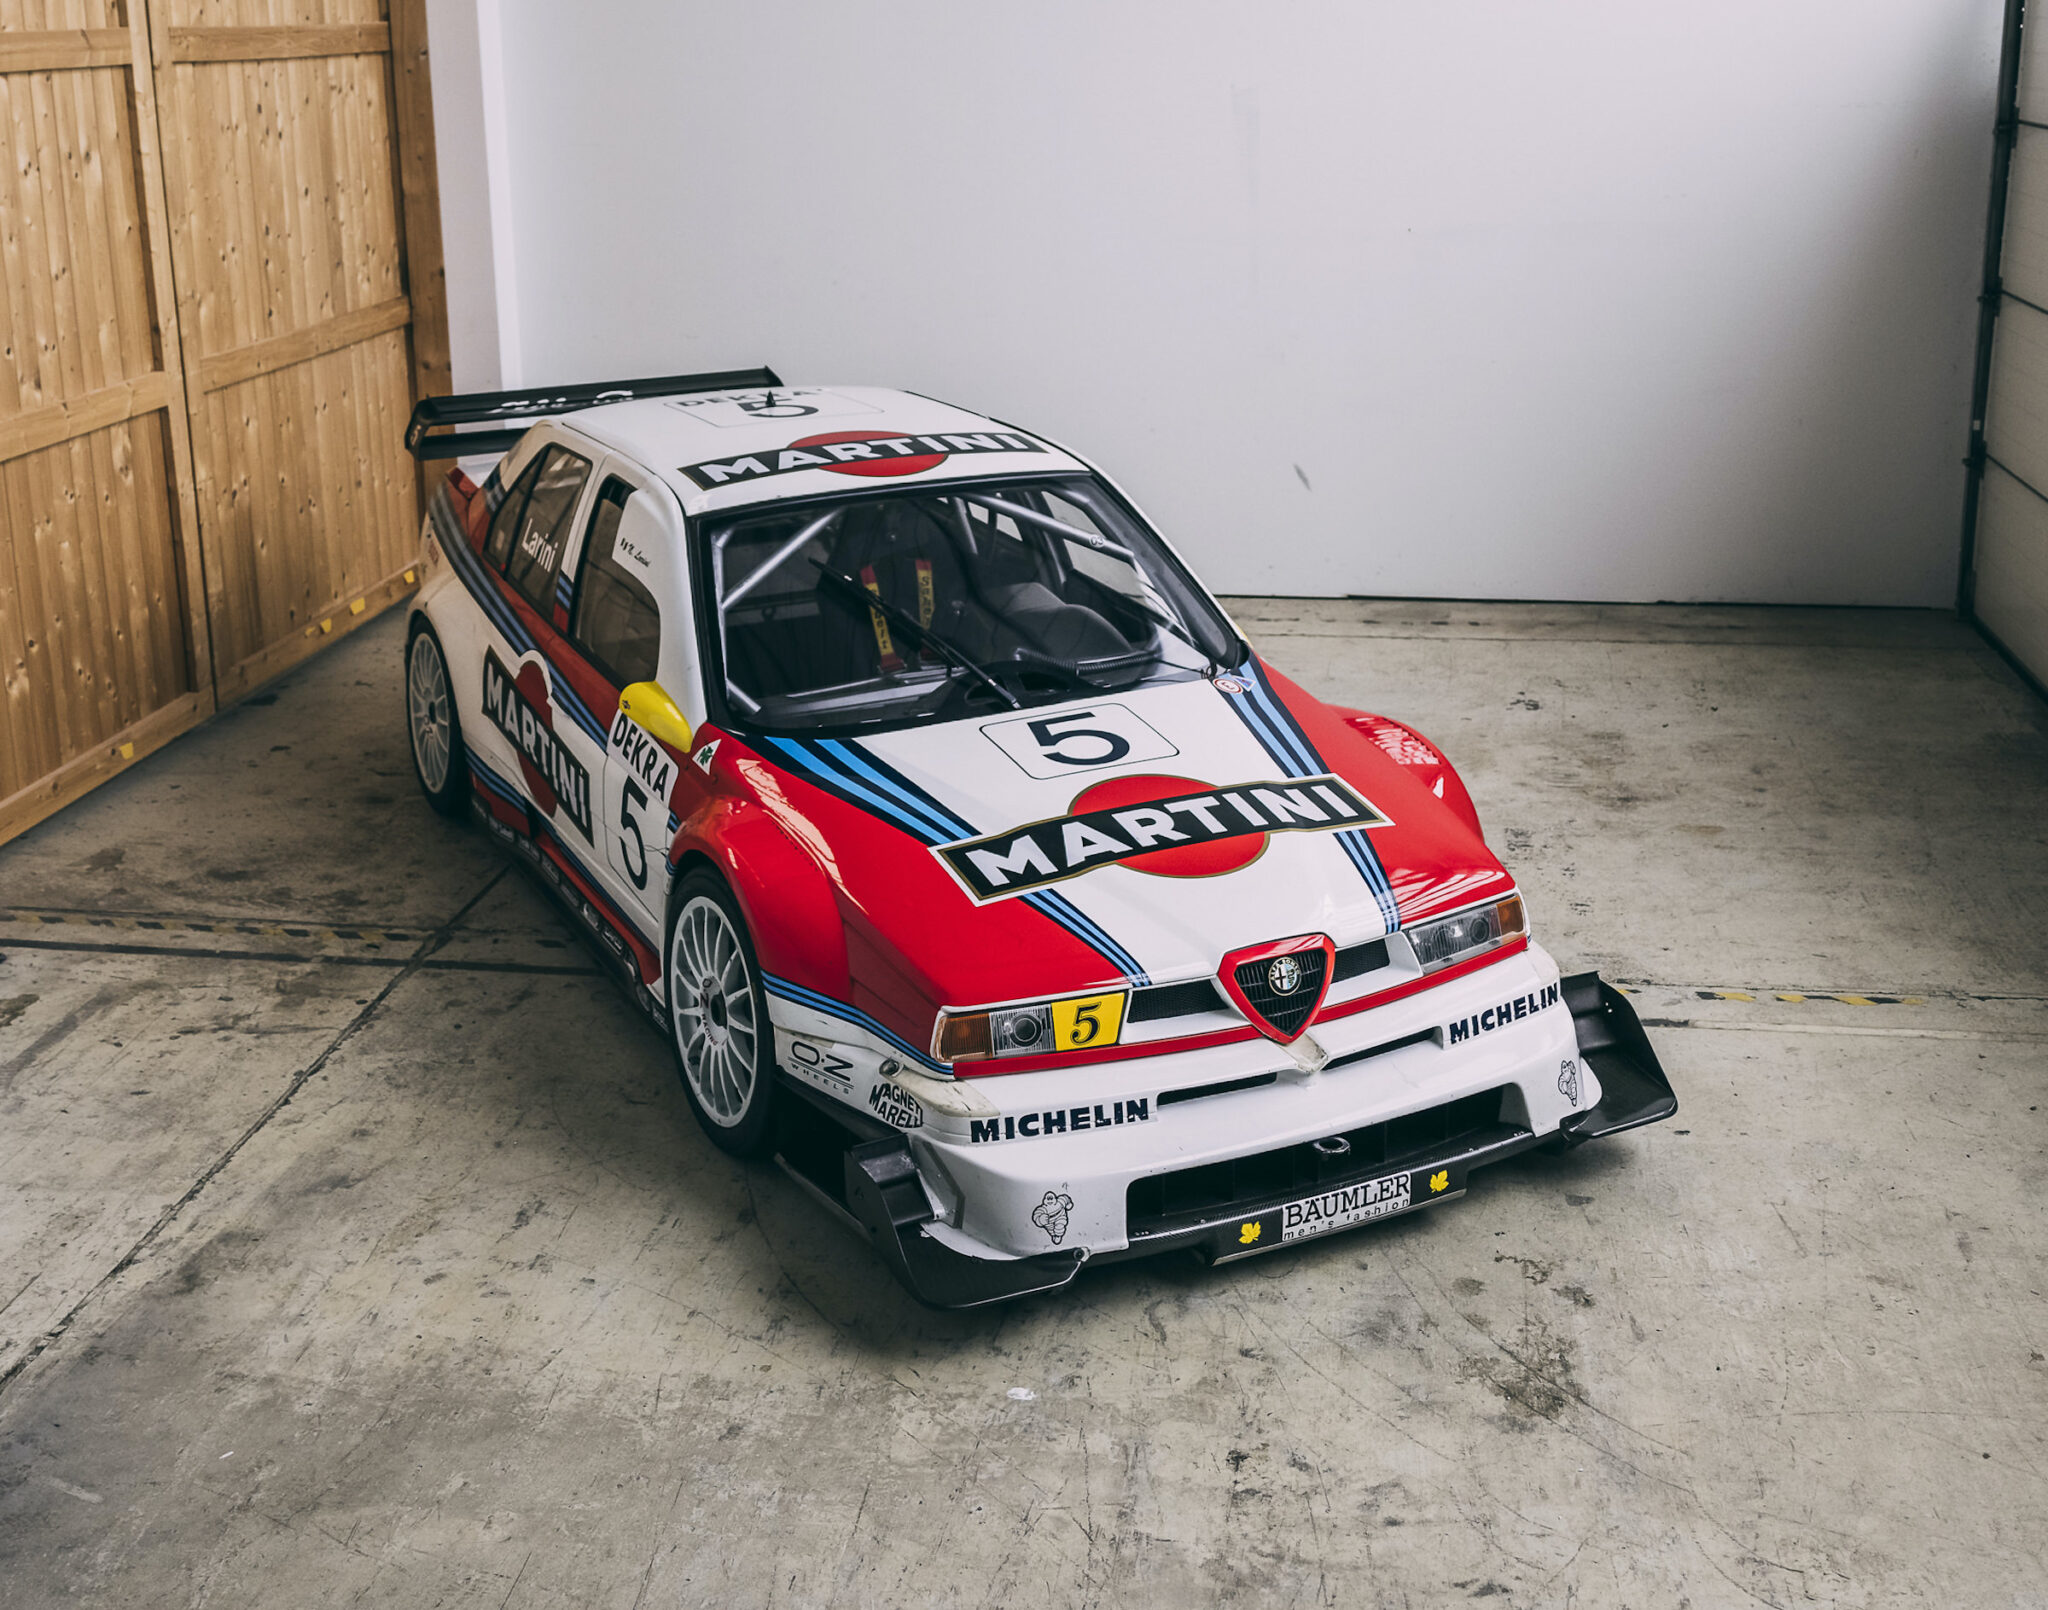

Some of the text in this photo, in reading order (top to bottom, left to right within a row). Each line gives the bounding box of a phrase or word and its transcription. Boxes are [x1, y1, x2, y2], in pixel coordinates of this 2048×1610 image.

[737, 398, 819, 418] 5
[698, 433, 1030, 484] MARTINI
[522, 518, 559, 572] Larini
[488, 662, 587, 828] MARTINI
[612, 712, 669, 801] DEKRA
[1026, 711, 1131, 766] 5
[619, 775, 648, 891] 5
[964, 785, 1360, 887] MARTINI
[1070, 1001, 1102, 1046] 5
[1449, 982, 1559, 1045] MICHELIN
[791, 1063, 850, 1095] WHEELS
[970, 1098, 1149, 1144] MICHELIN
[1283, 1198, 1409, 1241] men's fashion
[1285, 1174, 1410, 1229] BÄUMLER
